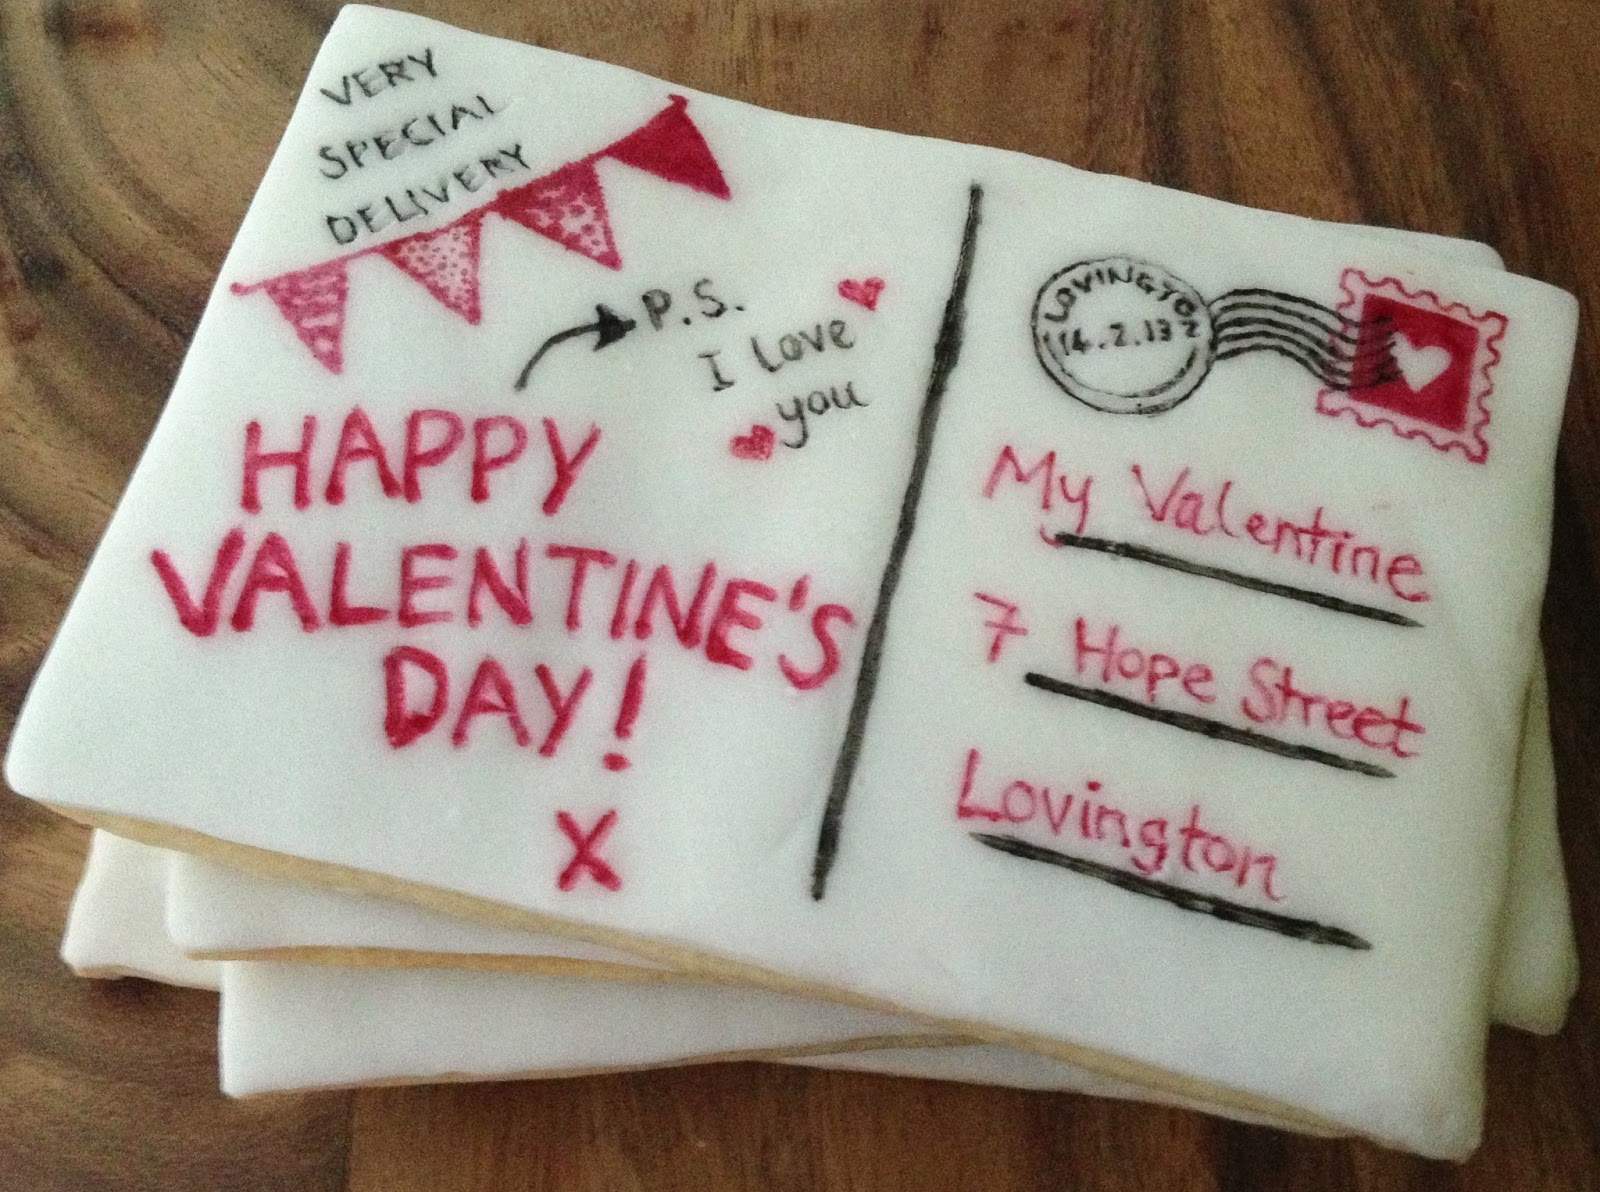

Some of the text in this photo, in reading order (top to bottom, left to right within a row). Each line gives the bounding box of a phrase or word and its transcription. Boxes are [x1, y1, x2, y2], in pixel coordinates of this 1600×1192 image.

[320, 47, 440, 108] VERY
[318, 95, 504, 181] SPECIAL
[325, 142, 532, 247] DELIVERY
[641, 277, 747, 332] P.S.
[698, 350, 736, 393] I
[776, 378, 870, 450] you
[240, 407, 601, 516] HAPPY
[982, 444, 1432, 602] My Valentine
[150, 528, 856, 691] VALENTINE'S
[383, 644, 648, 772] DAY!
[973, 591, 1427, 759] 7 Hope Street
[956, 747, 1288, 902] Lovington
